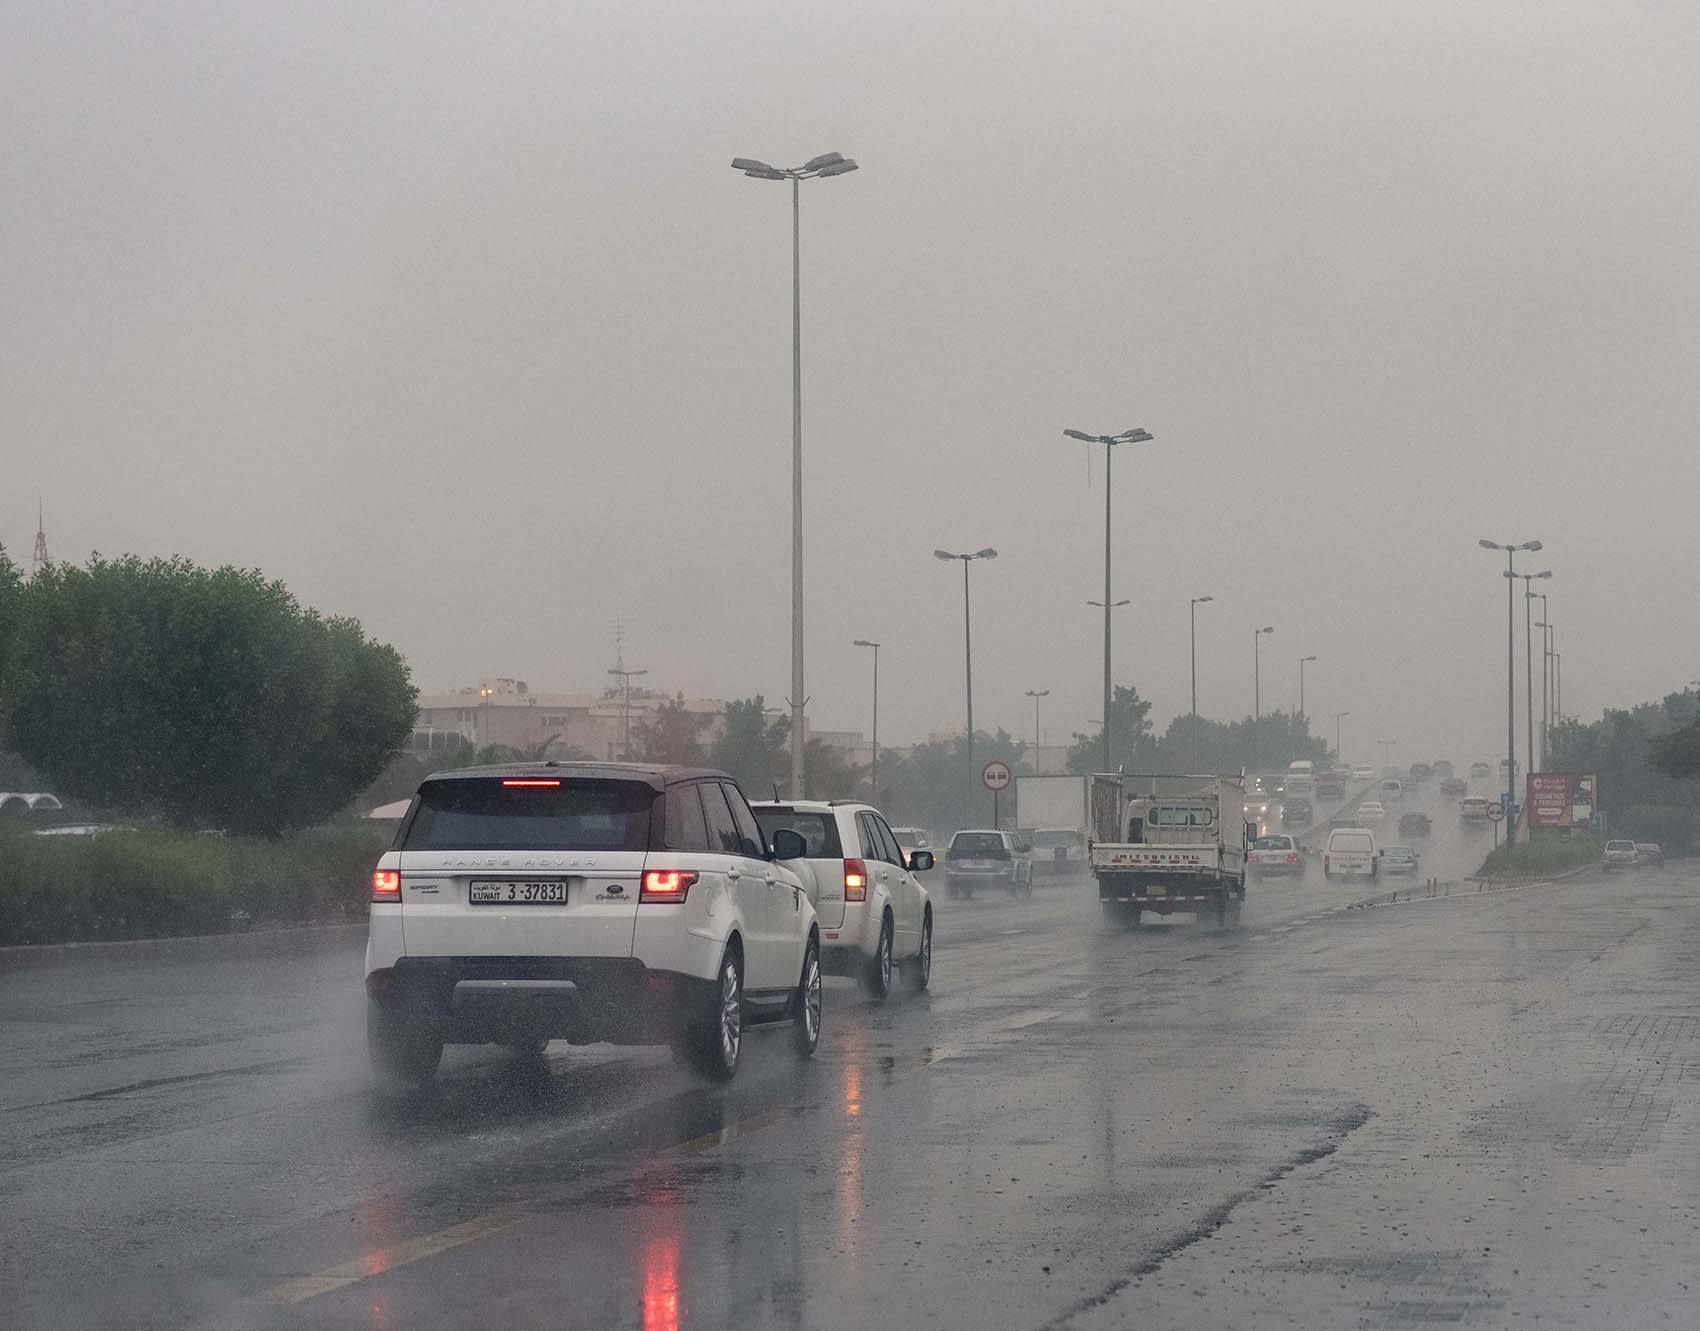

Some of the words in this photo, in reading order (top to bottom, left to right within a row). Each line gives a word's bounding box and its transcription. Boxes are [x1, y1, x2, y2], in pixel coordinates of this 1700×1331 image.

[442, 856, 511, 866] RANGE
[524, 856, 595, 866] ROVER
[472, 892, 500, 900] KUWAIT
